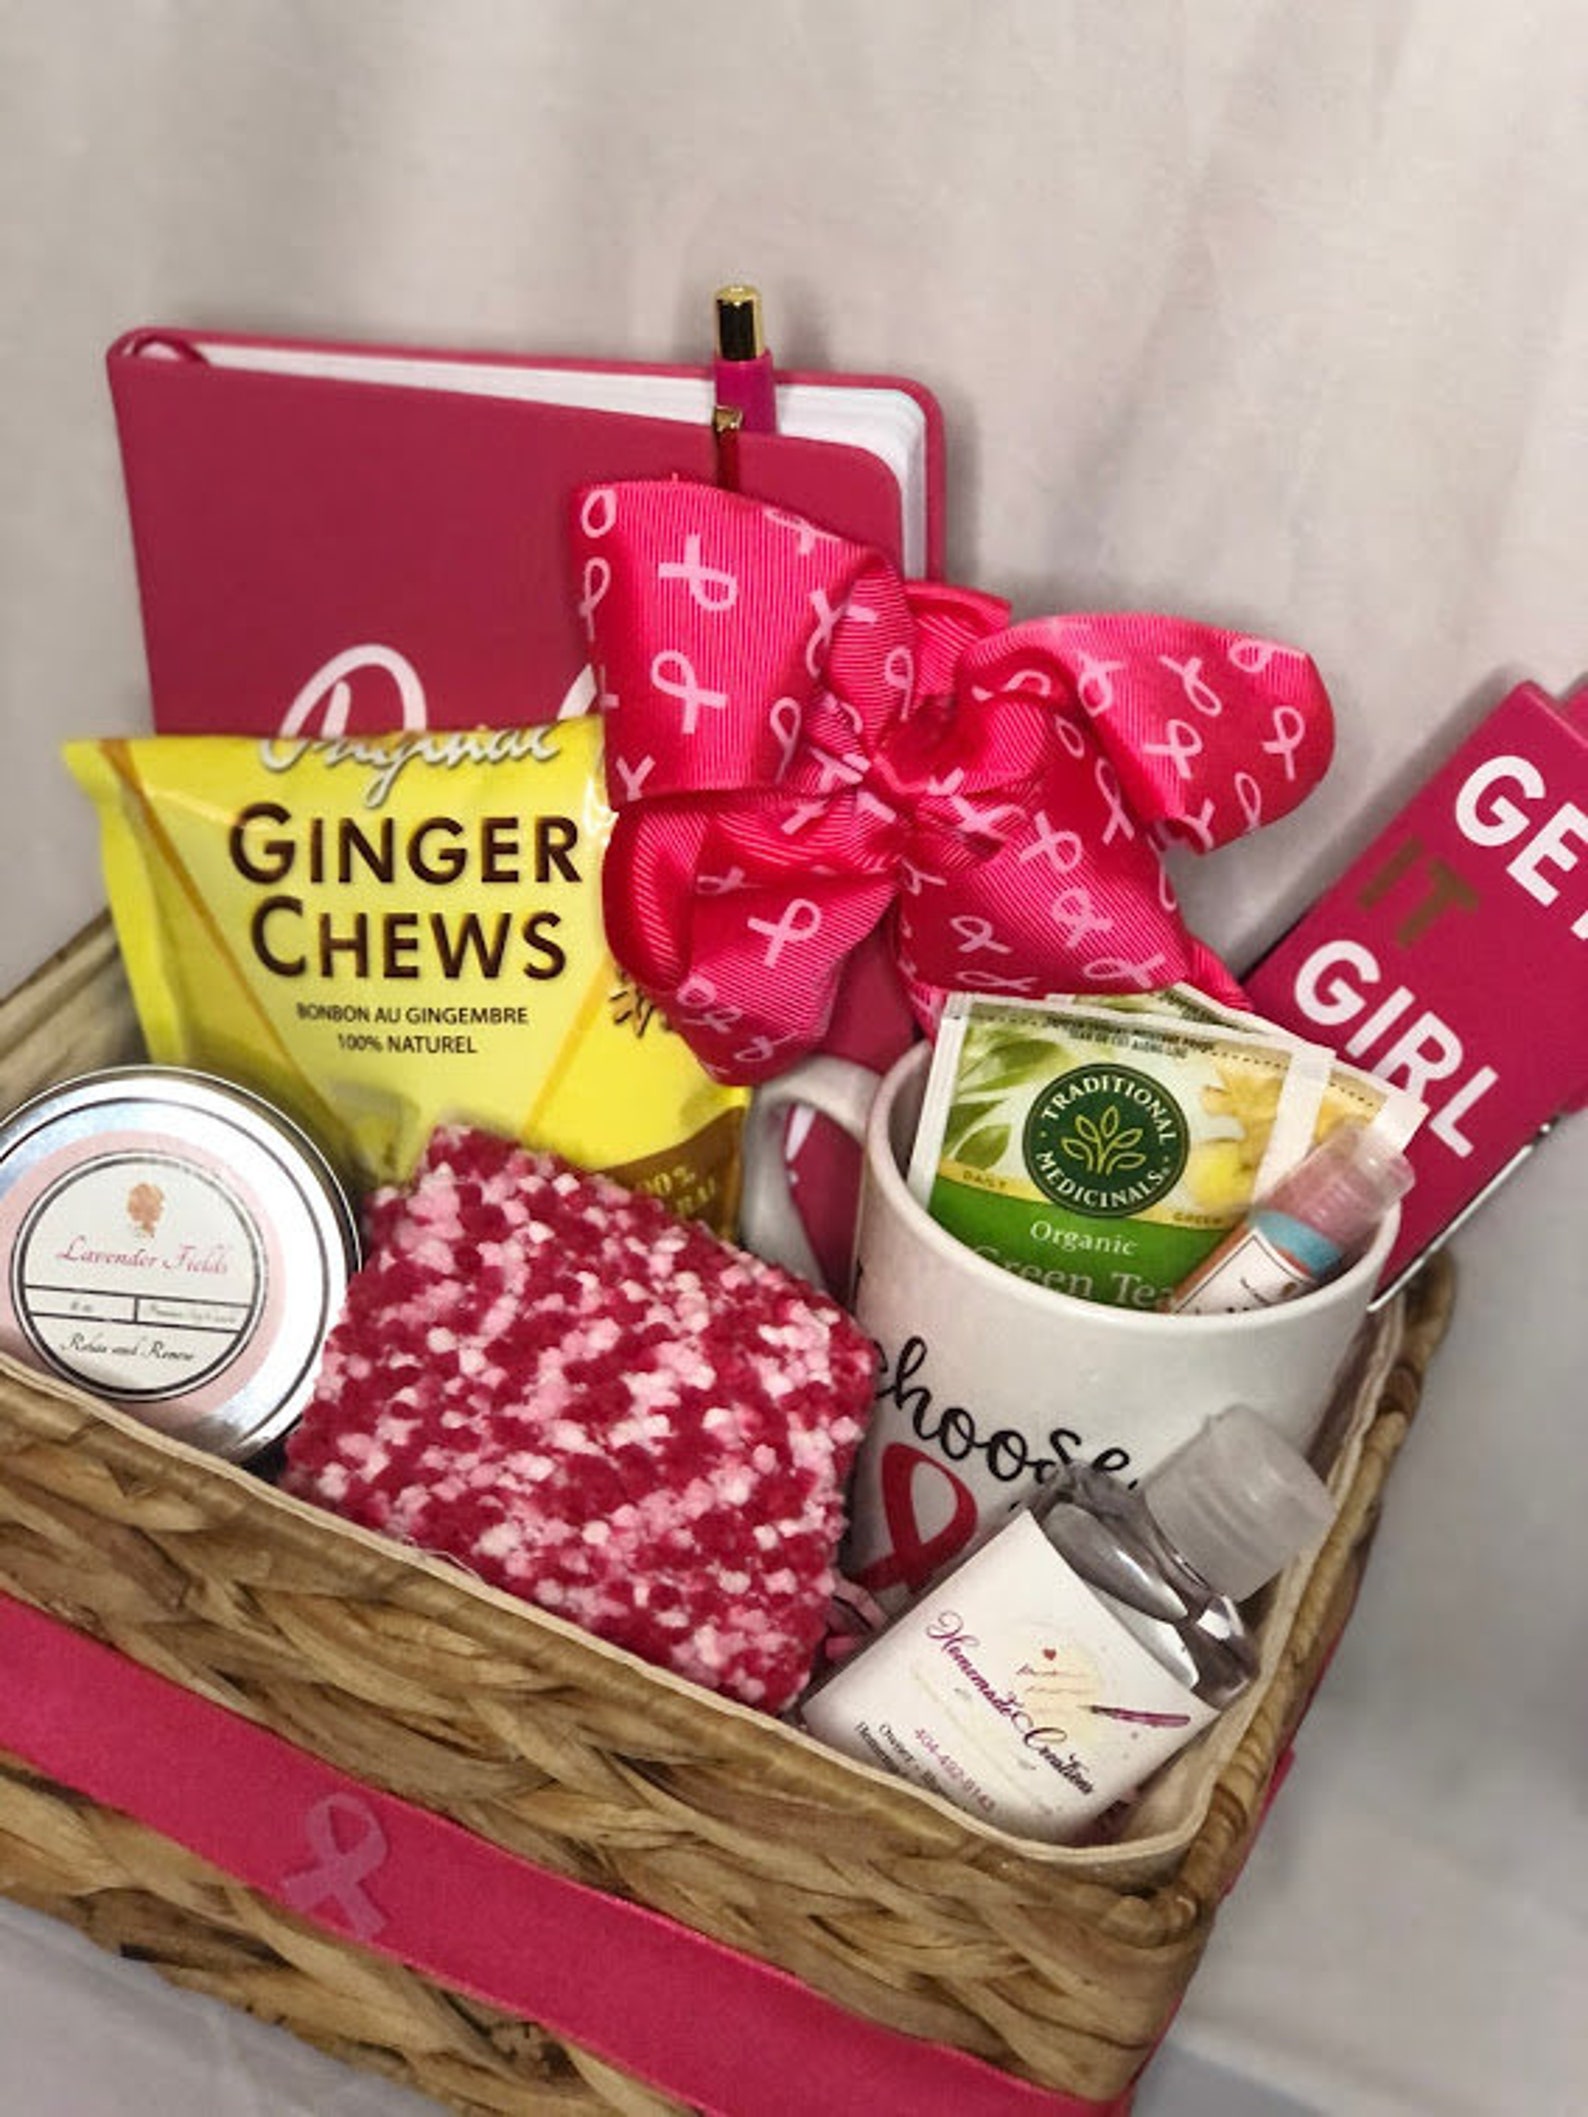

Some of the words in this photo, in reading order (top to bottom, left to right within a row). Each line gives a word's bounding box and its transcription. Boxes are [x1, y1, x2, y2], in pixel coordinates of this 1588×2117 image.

[228, 801, 583, 886] GINGER
[1456, 755, 1588, 941] GE
[1357, 836, 1480, 951] IT
[250, 894, 568, 981] CHEWS
[297, 1002, 371, 1024] BONBON
[374, 1007, 401, 1024] AU
[405, 1007, 529, 1025] GINGEMBRE
[337, 1033, 383, 1052] 100%
[387, 1035, 478, 1054] NATUREL
[1294, 940, 1499, 1159] GIRL
[1041, 1074, 1177, 1146] TRADITIONAL
[1035, 1150, 1164, 1208] MEDICINALS
[56, 1234, 158, 1269] Lavender
[1029, 1220, 1139, 1257] Organic
[926, 1609, 1026, 1720] Homemade
